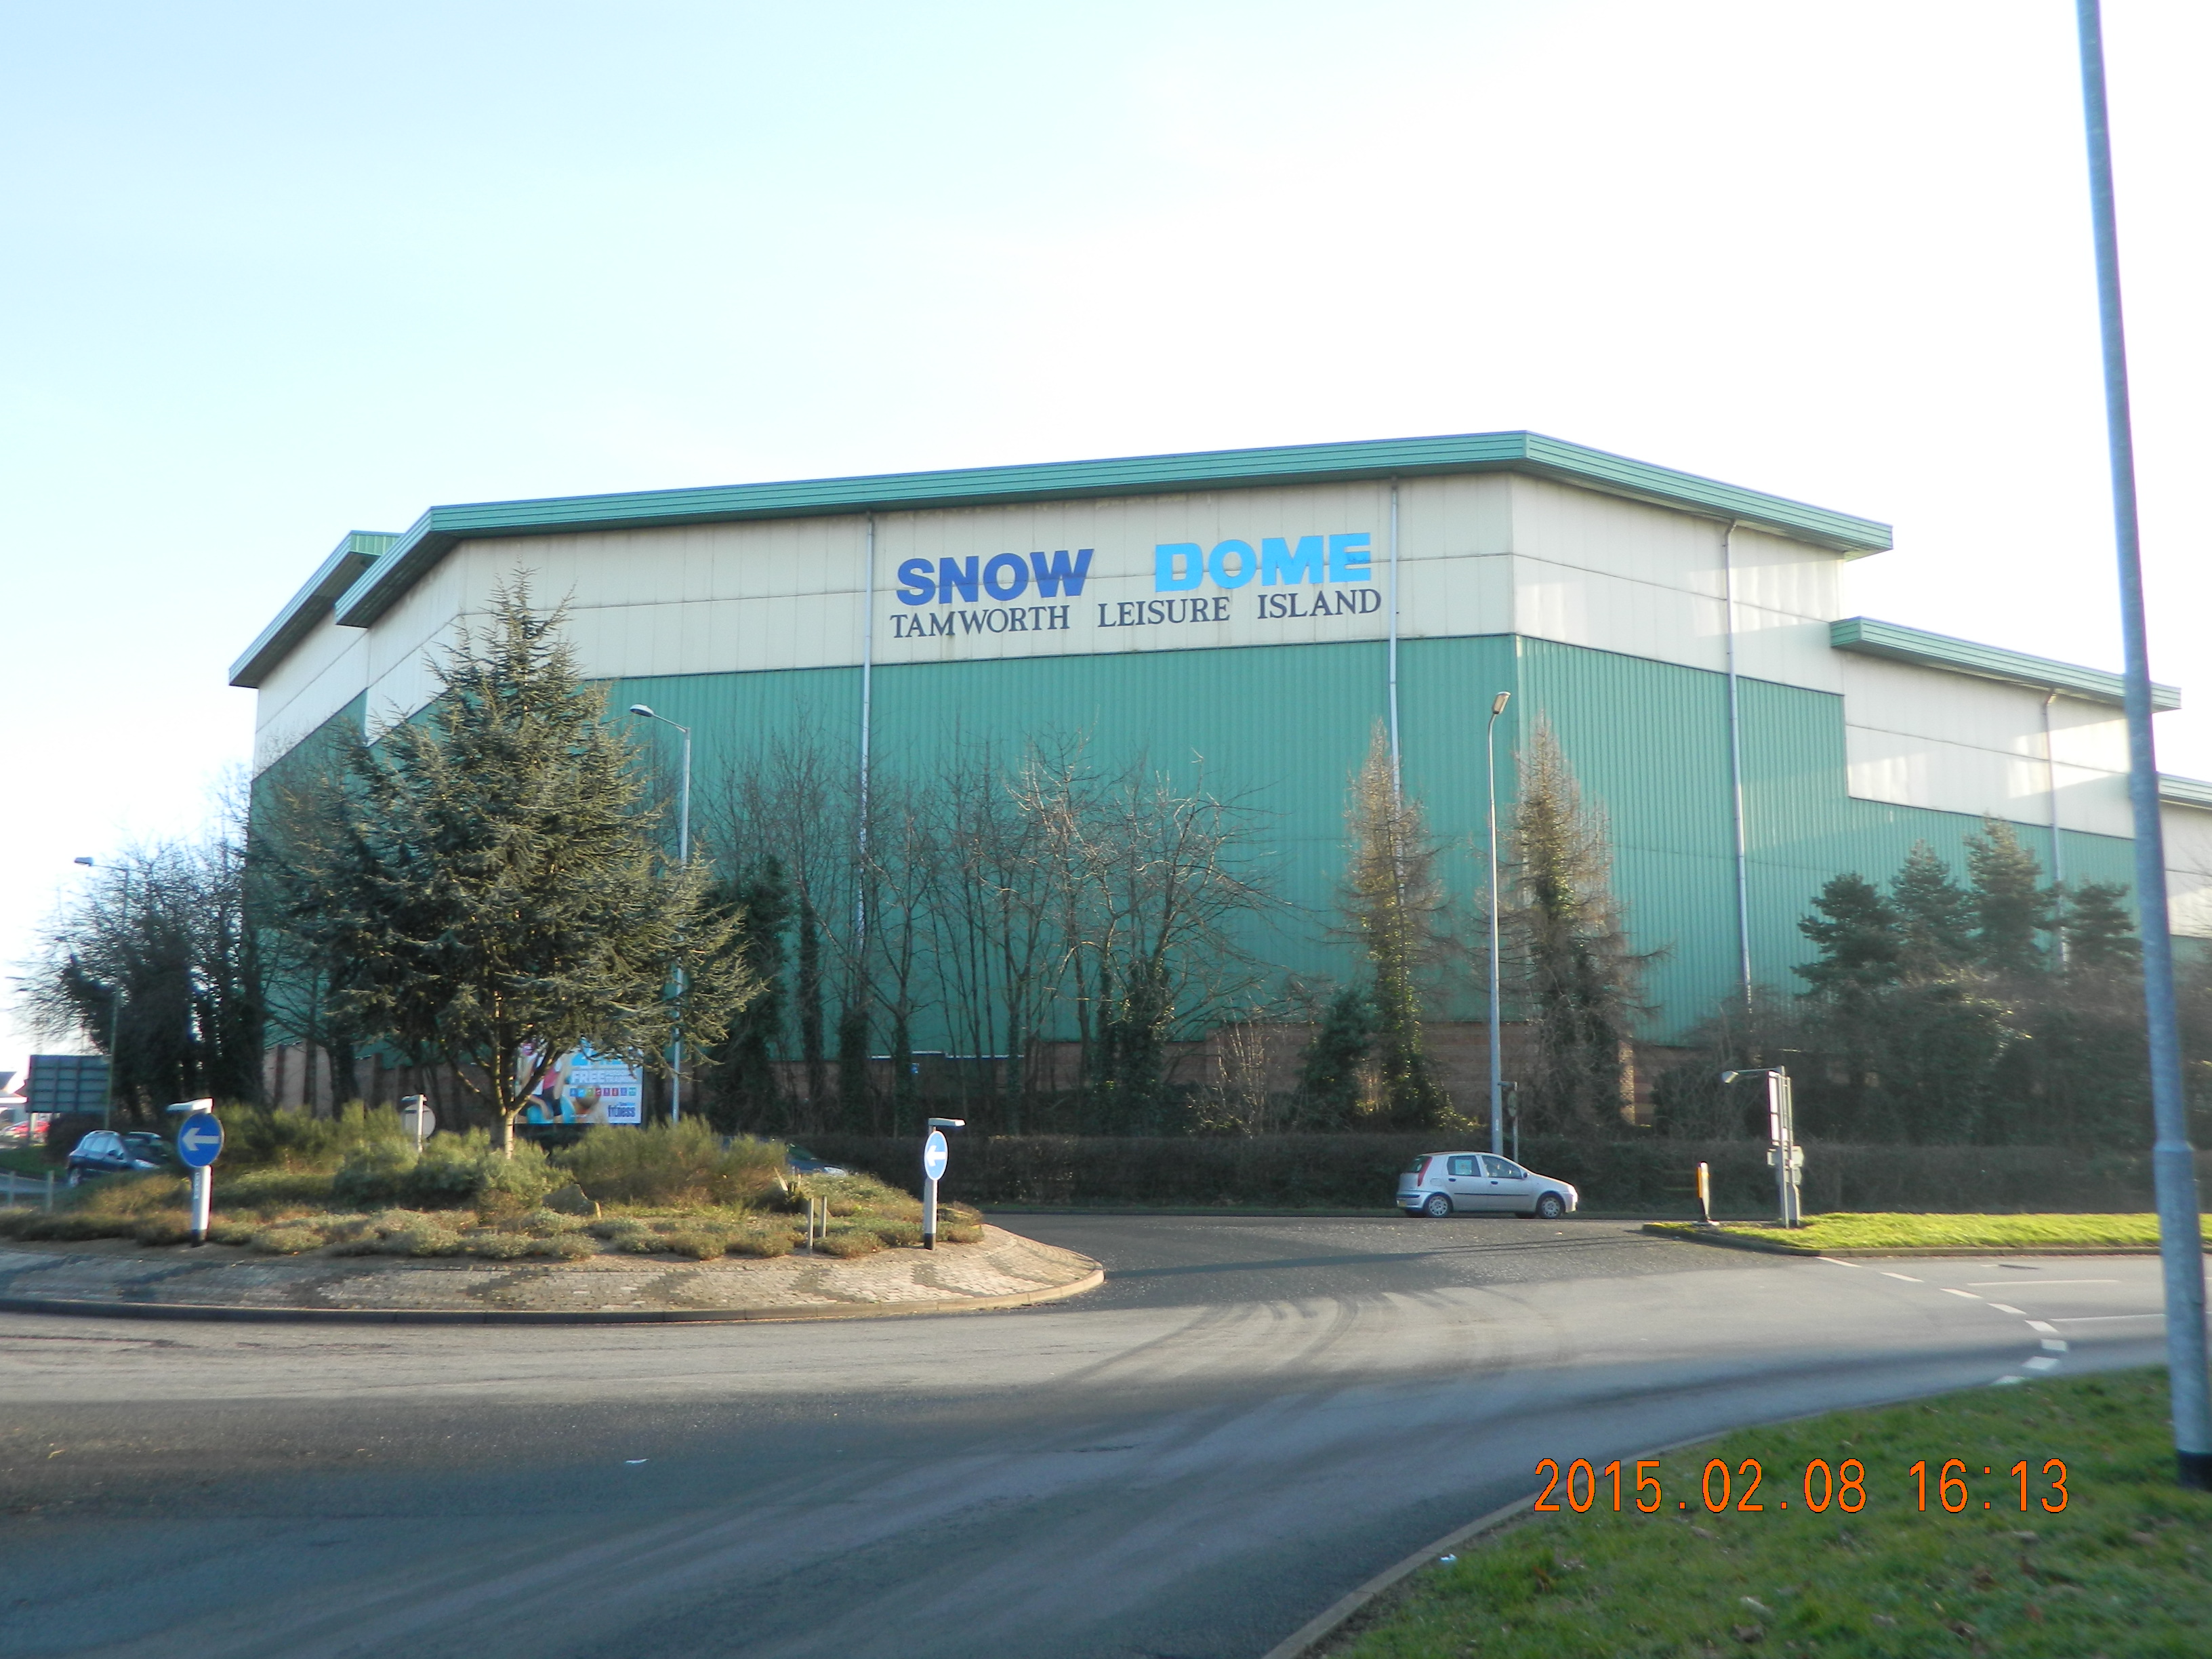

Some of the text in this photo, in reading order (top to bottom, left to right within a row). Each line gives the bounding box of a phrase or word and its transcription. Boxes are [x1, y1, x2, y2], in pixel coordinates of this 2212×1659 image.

[897, 532, 1372, 605] SNOW DOME
[890, 588, 1382, 638] TAMWORTH LEISURE ISLAND
[571, 1070, 605, 1084] FREE
